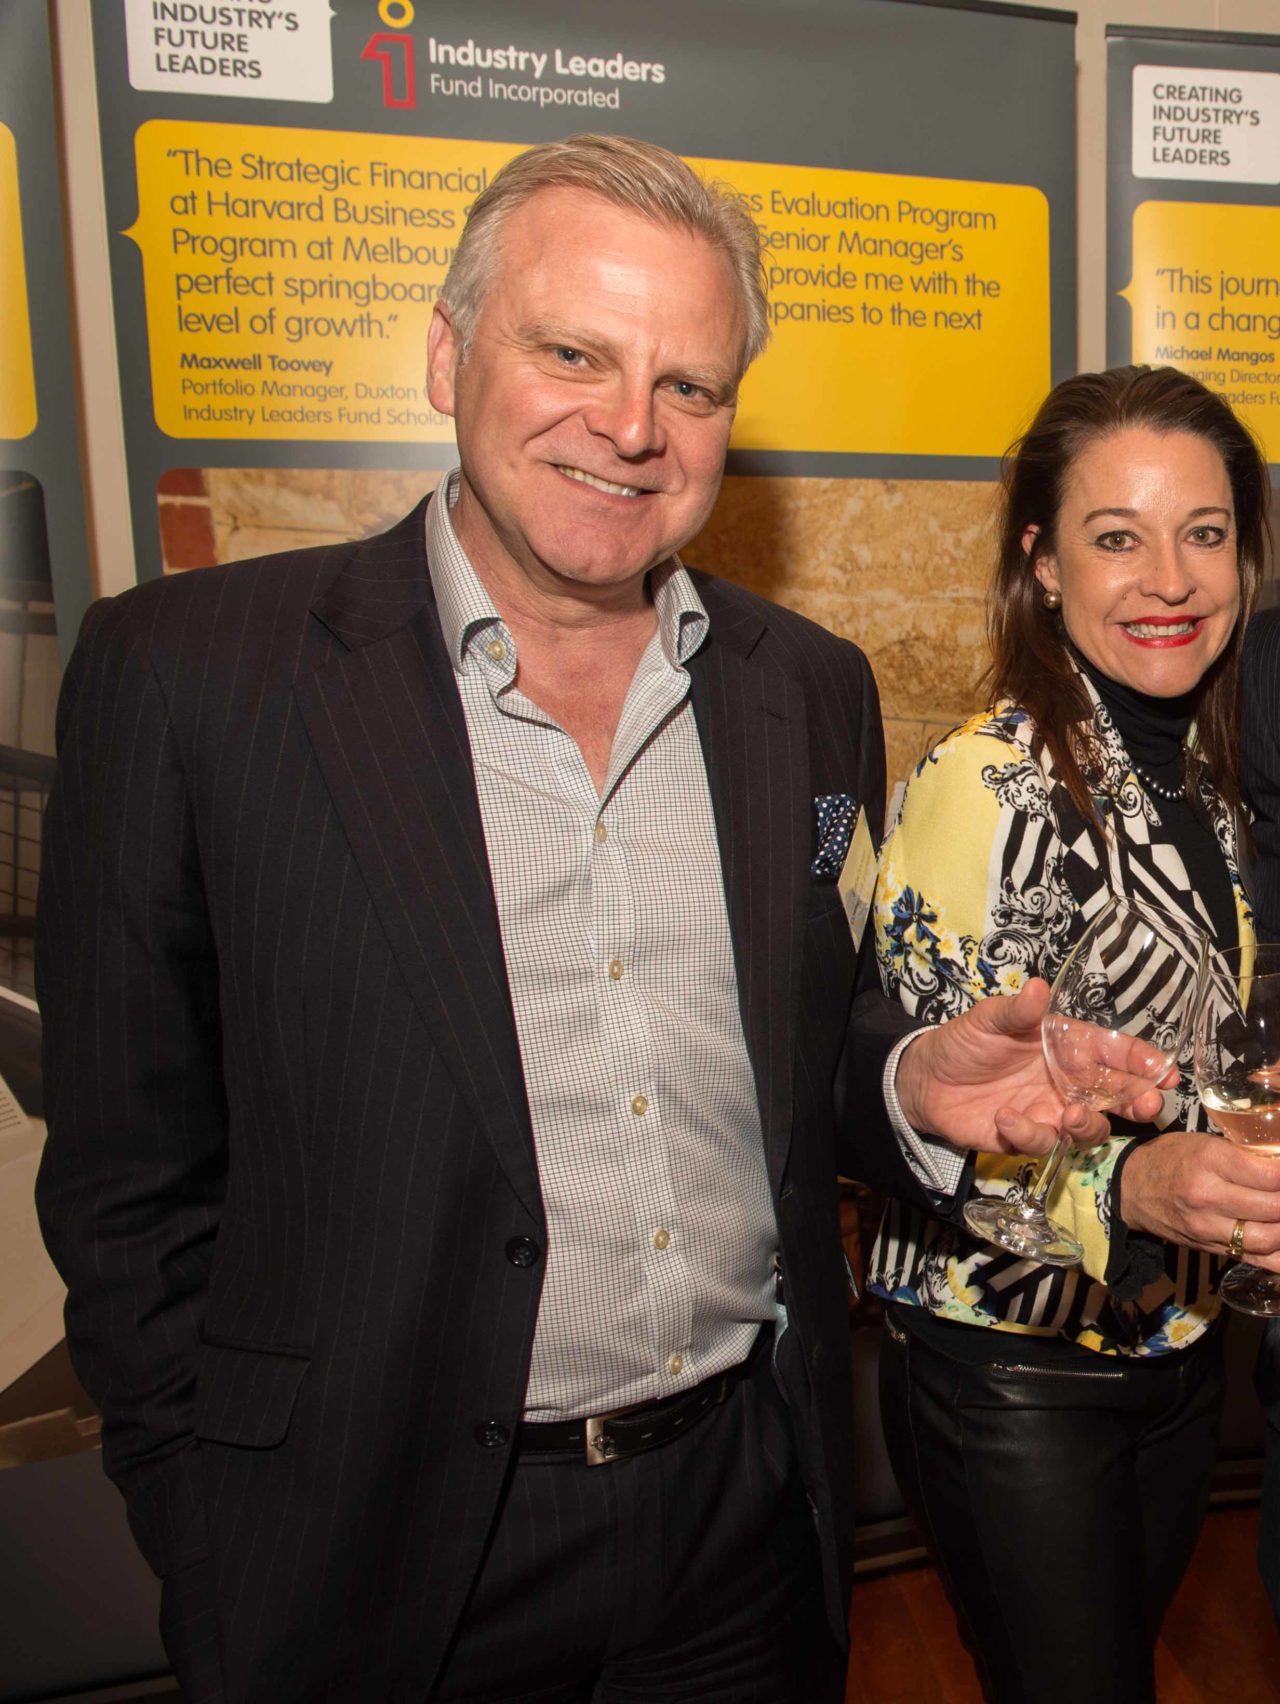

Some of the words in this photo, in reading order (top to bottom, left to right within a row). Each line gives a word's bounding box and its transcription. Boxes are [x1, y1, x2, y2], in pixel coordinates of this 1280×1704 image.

[152, 2, 299, 31] INDUSTRY'S
[154, 27, 249, 52] FUTURE
[155, 53, 262, 79] LEADERS
[428, 37, 548, 79] Industry
[554, 48, 666, 84] Leaders
[431, 73, 482, 97] Fund
[489, 78, 620, 109] Incorporated
[1153, 84, 1242, 104] CREATING
[1153, 105, 1260, 126] INDUSTRY'S
[1153, 126, 1222, 145] FUTURE
[1152, 147, 1230, 166] LEADERS
[167, 149, 232, 178] "The
[240, 154, 360, 191] Strategic
[370, 161, 488, 193] Financial
[771, 190, 890, 223] Evaluation
[898, 200, 997, 233] Program
[170, 192, 197, 216] at
[207, 190, 323, 222] Harvard
[334, 198, 455, 229] Business
[838, 230, 963, 265] Manager's
[172, 228, 296, 263] Program
[307, 237, 334, 260] at
[770, 263, 857, 291] provide
[865, 272, 903, 292] me
[911, 269, 958, 295] with
[965, 271, 1001, 299] the
[176, 268, 274, 300] perfect
[862, 303, 883, 325] to
[891, 302, 926, 328] the
[934, 308, 983, 331] next
[178, 305, 240, 333] level
[250, 307, 276, 334] of
[1156, 306, 1175, 329] in
[1184, 312, 1200, 331] a
[180, 353, 262, 371] Maxwell
[268, 355, 333, 376] Toovey
[1155, 346, 1211, 361] Michael
[1217, 348, 1275, 365] Mangos
[182, 378, 255, 396] Portfolio
[261, 381, 348, 401] Manager,
[355, 382, 417, 401] Duxton
[183, 404, 255, 426] Industry
[262, 406, 332, 423] Leaders
[338, 407, 381, 424] Fund
